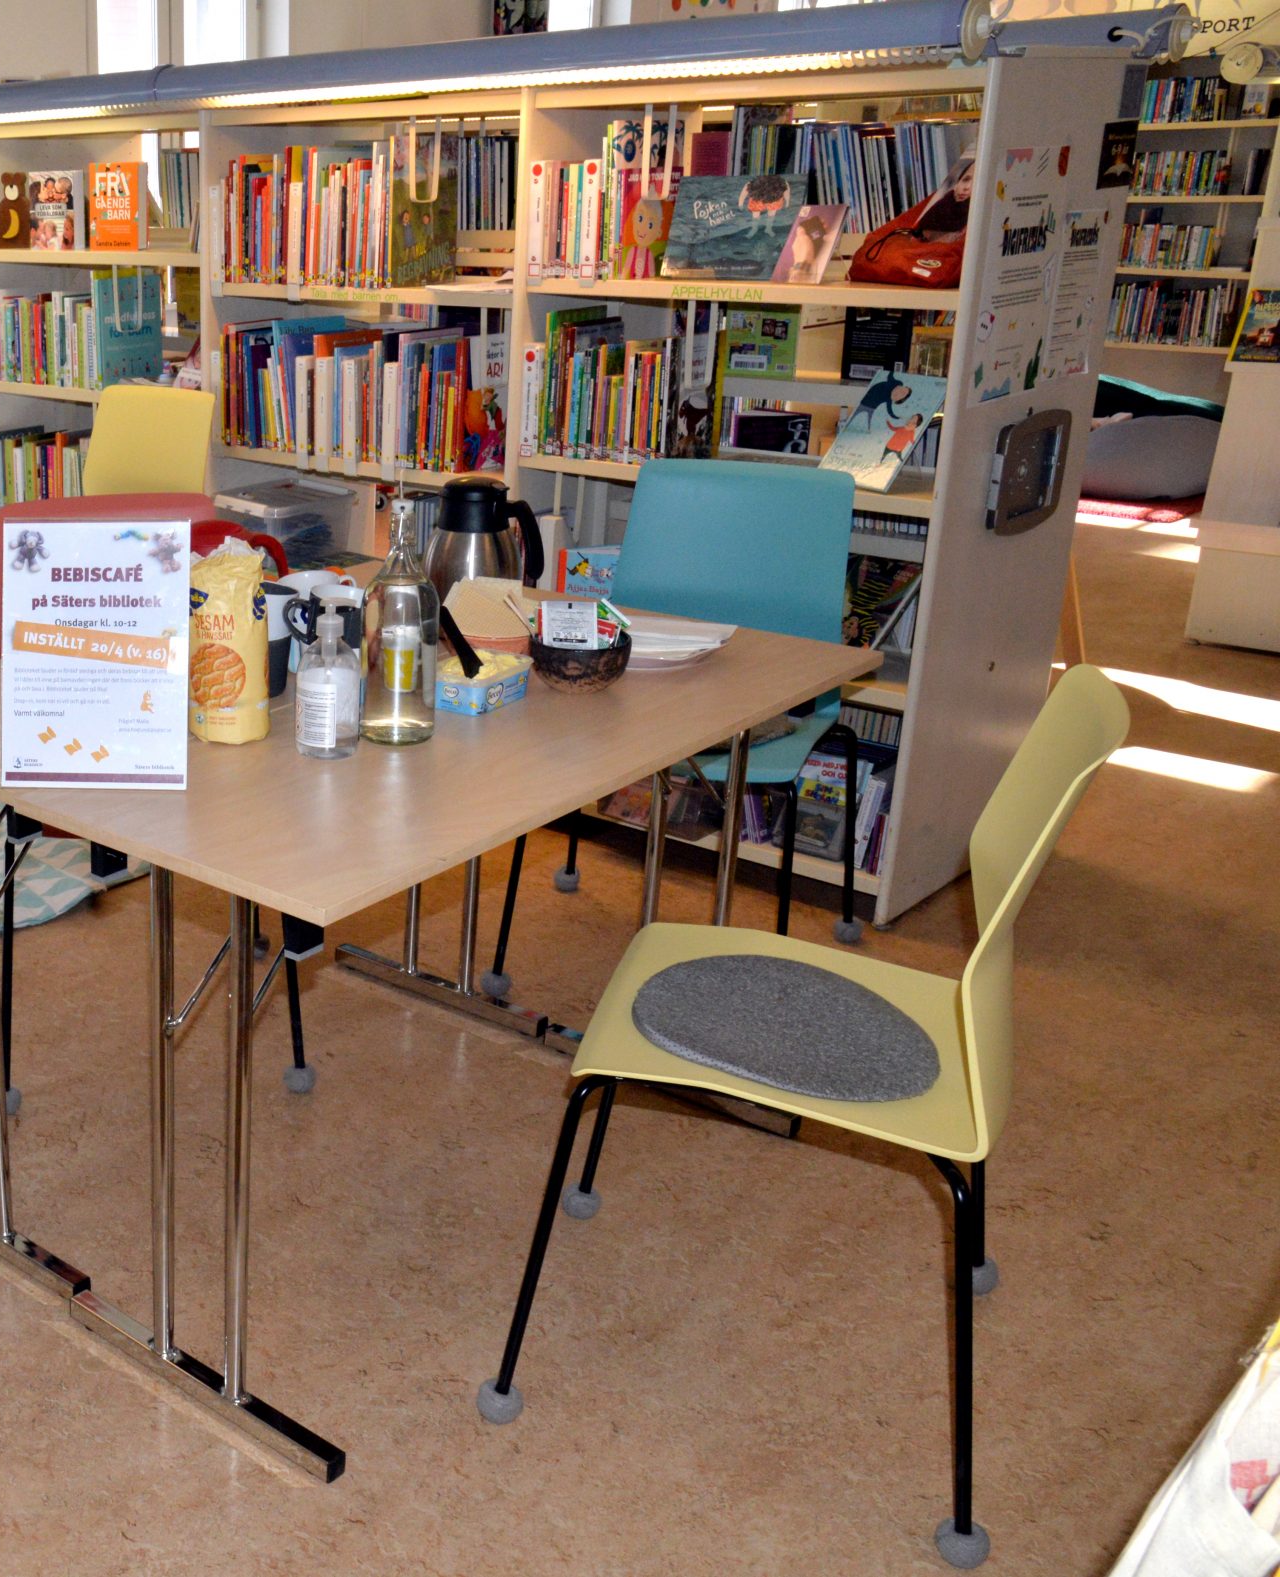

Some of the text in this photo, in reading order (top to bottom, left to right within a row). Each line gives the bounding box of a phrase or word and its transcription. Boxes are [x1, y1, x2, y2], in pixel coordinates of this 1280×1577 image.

[1200, 15, 1255, 34] PORT
[95, 197, 130, 209] GÅENDE
[693, 200, 727, 220] Pojken
[107, 209, 131, 220] BARN
[671, 285, 763, 301] ÄPPELHYLLAN
[104, 312, 156, 324] midfuless
[51, 564, 143, 583] BEBISCAFÉ
[31, 594, 162, 611] på Säters bibliotek
[54, 618, 98, 628] Onsdagar
[100, 618, 111, 627] kl.
[194, 613, 235, 630] SESAM
[23, 631, 167, 661] INSTÄLLT 20/4 (v. 16)
[33, 709, 65, 717] välkomna!
